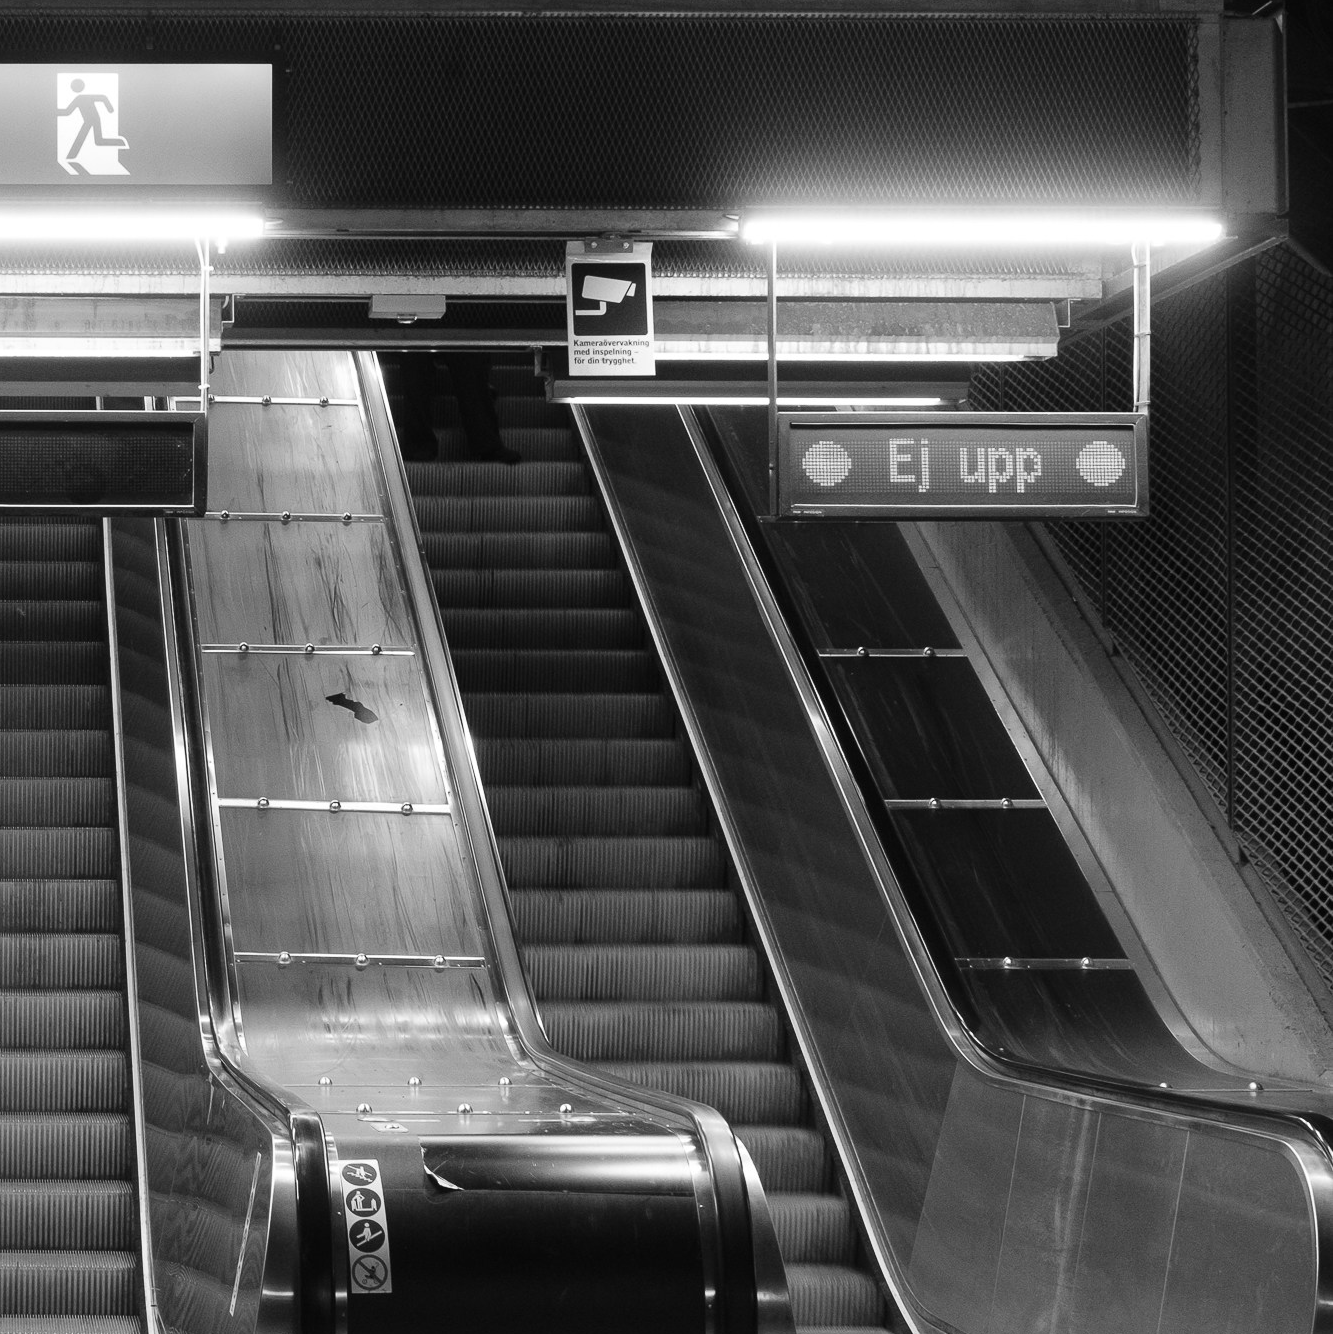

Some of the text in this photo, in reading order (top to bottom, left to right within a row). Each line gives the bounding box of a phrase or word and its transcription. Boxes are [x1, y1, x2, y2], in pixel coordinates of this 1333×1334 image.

[573, 339, 650, 347] Kameraövervakning
[573, 348, 590, 356] med
[592, 348, 632, 356] inspelning
[574, 357, 585, 365] för
[587, 357, 600, 365] din
[889, 438, 1042, 493] Ej upp
